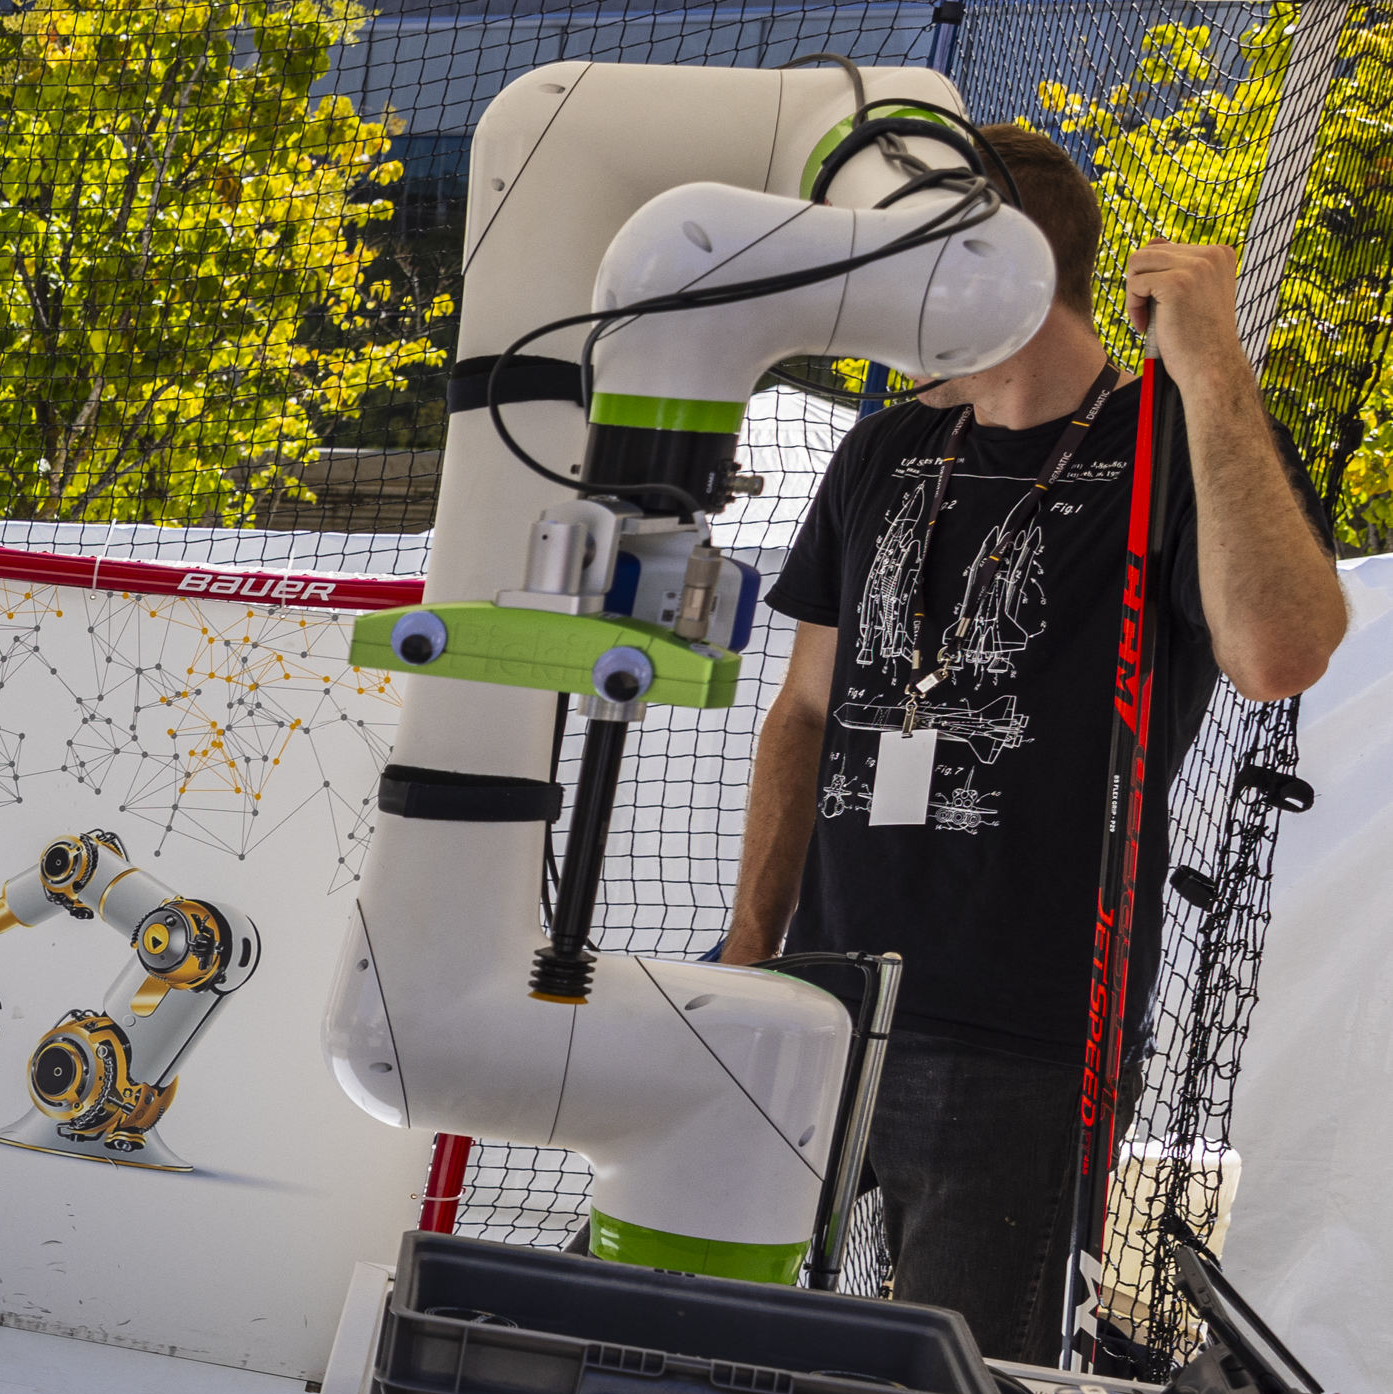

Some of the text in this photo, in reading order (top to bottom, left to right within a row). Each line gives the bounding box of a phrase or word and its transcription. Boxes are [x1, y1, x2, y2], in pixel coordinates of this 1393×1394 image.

[1085, 389, 1111, 421] DEMATIC
[175, 572, 337, 602] BAUER
[1111, 783, 1119, 800] FLEX
[1080, 886, 1115, 1128] JETSPEED
